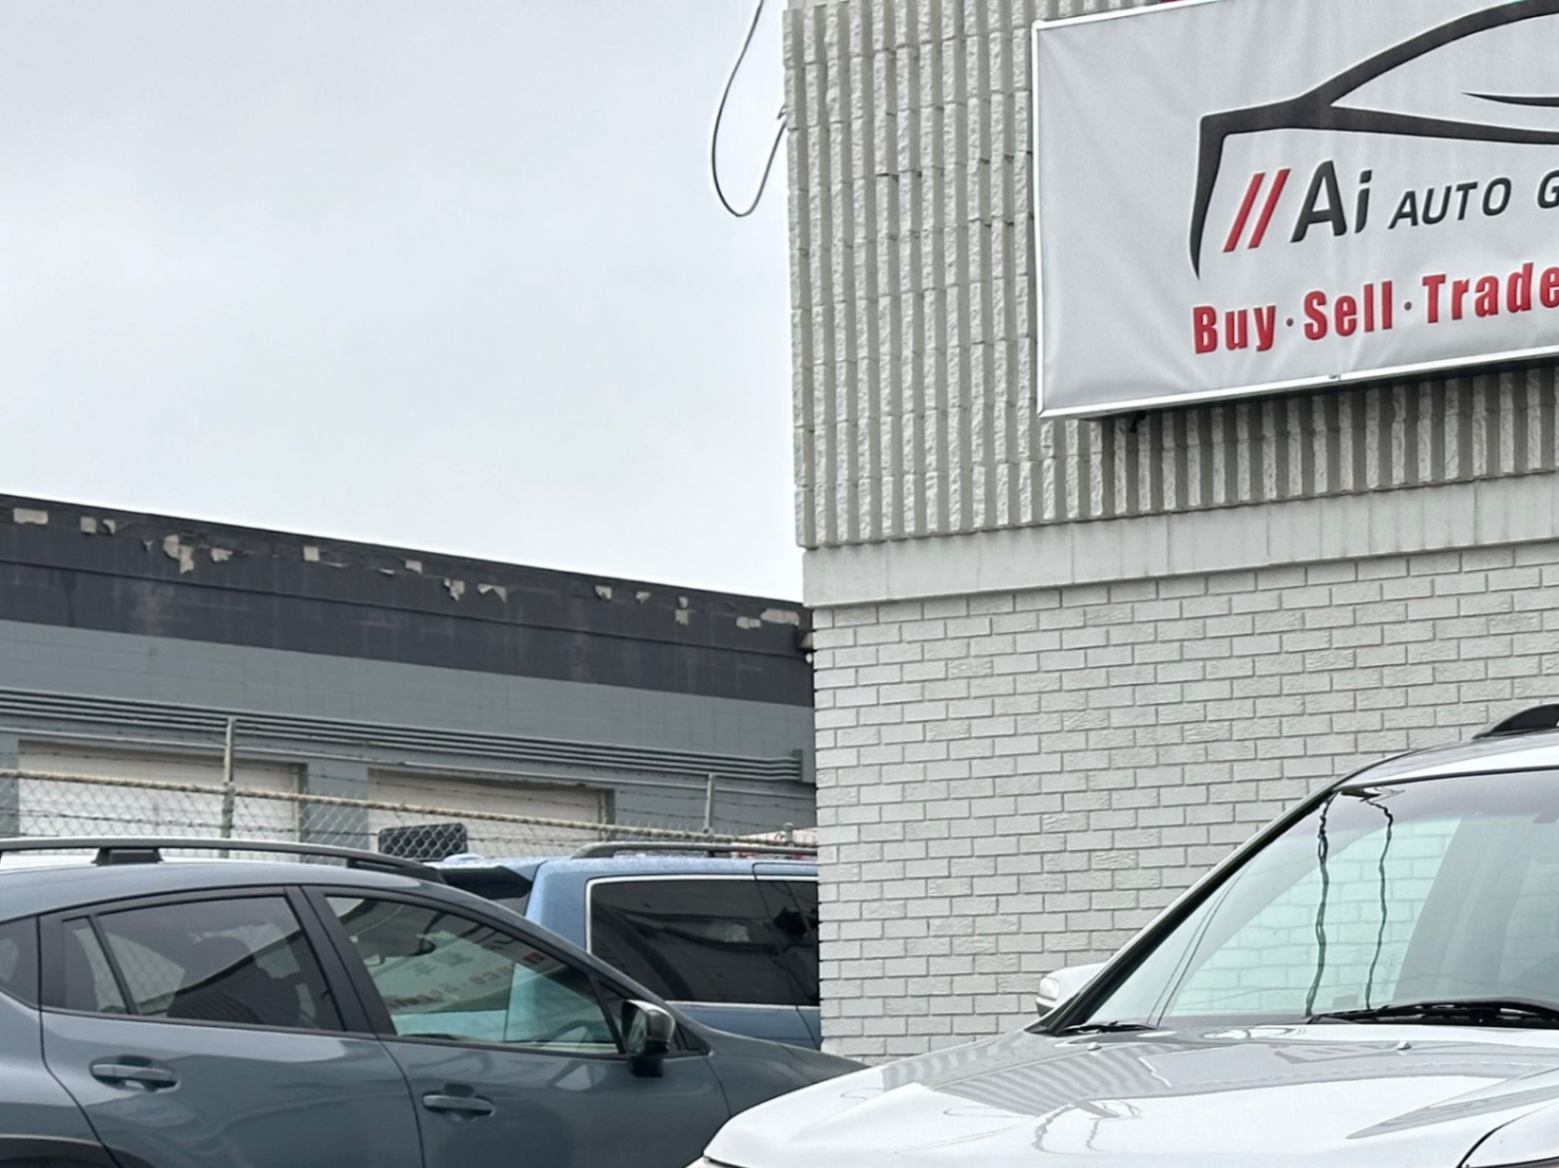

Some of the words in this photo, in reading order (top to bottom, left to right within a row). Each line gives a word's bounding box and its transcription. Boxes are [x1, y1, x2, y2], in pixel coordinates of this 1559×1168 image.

[1387, 176, 1513, 231] AUTO
[1192, 304, 1278, 355] Buy
[1303, 279, 1394, 341] Sell
